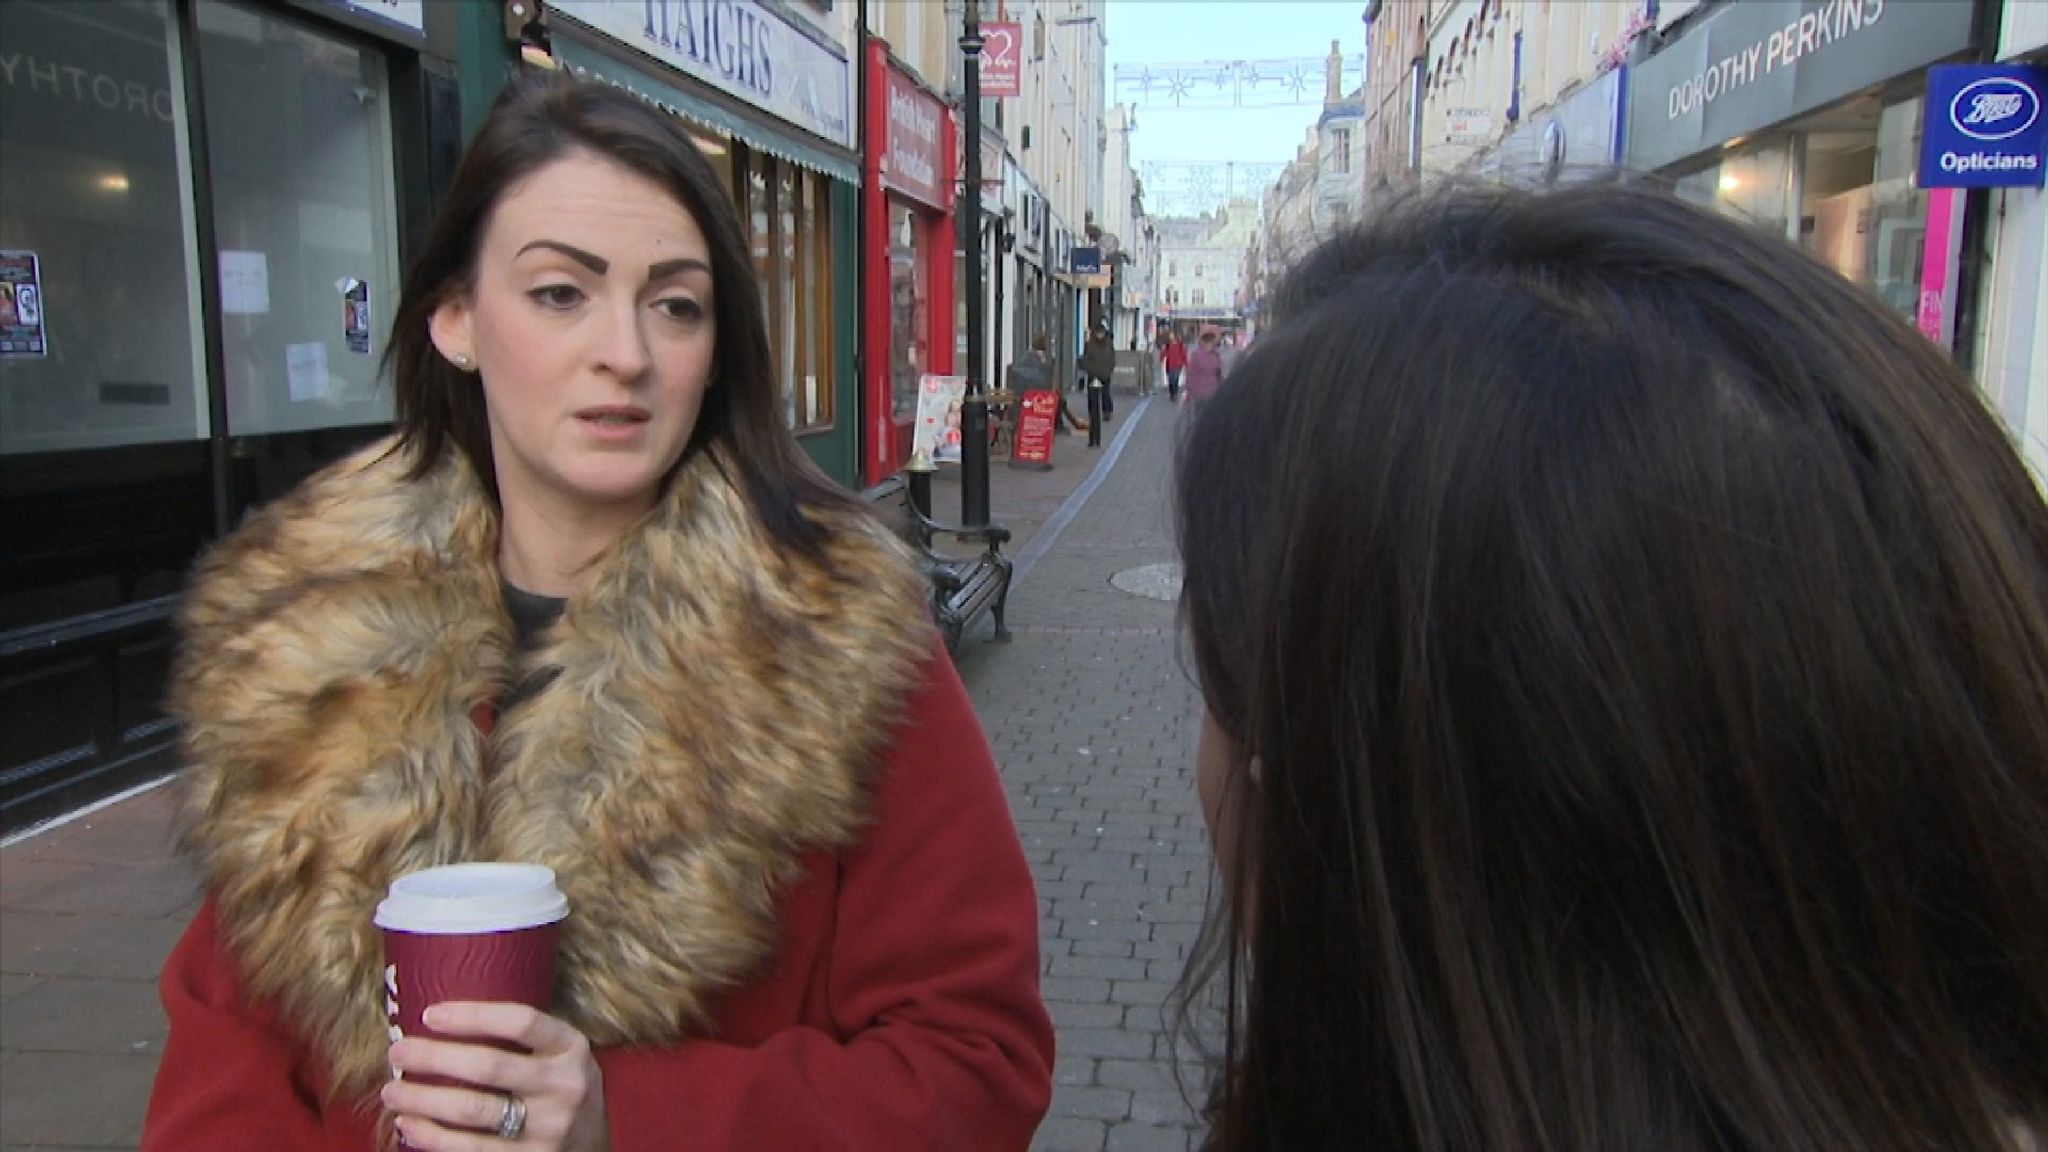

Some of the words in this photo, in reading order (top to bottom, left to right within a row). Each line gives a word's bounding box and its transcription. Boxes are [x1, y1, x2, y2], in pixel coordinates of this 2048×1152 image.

[1669, 40, 1762, 119] DOROTHY
[1766, 0, 1884, 73] PERKINS
[1940, 151, 2038, 174] Opticians
